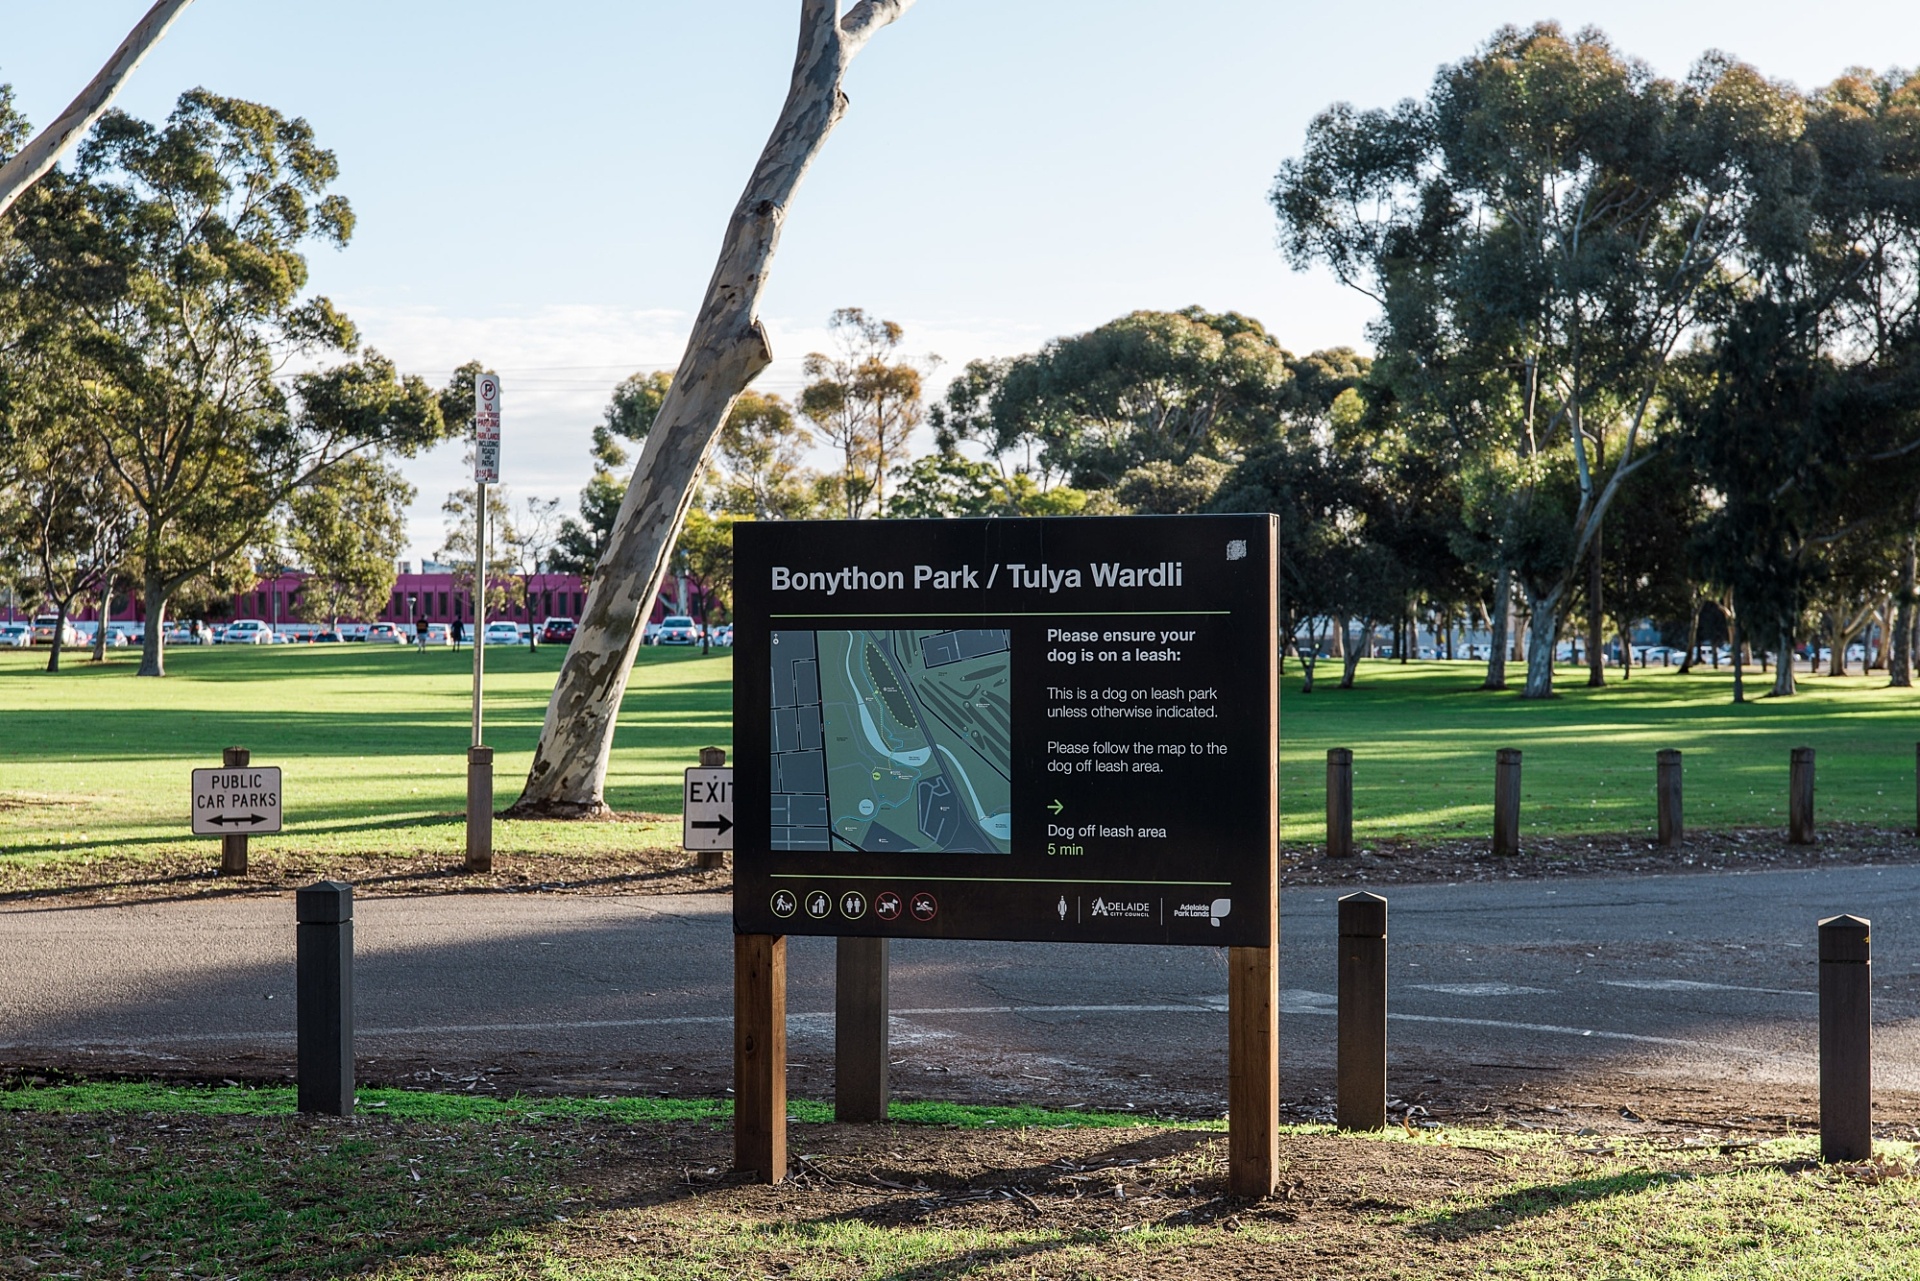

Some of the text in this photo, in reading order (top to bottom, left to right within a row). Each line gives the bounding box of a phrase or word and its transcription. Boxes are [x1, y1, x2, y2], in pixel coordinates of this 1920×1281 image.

[484, 403, 493, 411] NO
[771, 561, 1182, 596] Bonython Park / Tulya Wardli
[1047, 628, 1196, 645] Please ensure your
[1047, 647, 1181, 665] dog is on a leash:
[1047, 686, 1218, 703] This is a dog on leash park
[1047, 704, 1218, 718] unless otherwise indicated.
[1047, 740, 1228, 758] Please follow the map to the
[1047, 759, 1164, 775] dog off leash area.
[211, 774, 262, 789] PUBLIC
[197, 793, 276, 809] CAR PARKS
[1047, 823, 1167, 840] Dog off leash area
[1047, 842, 1084, 856] 5 min
[1173, 909, 1210, 918] Park Lands
[1180, 903, 1210, 911] Adelaide
